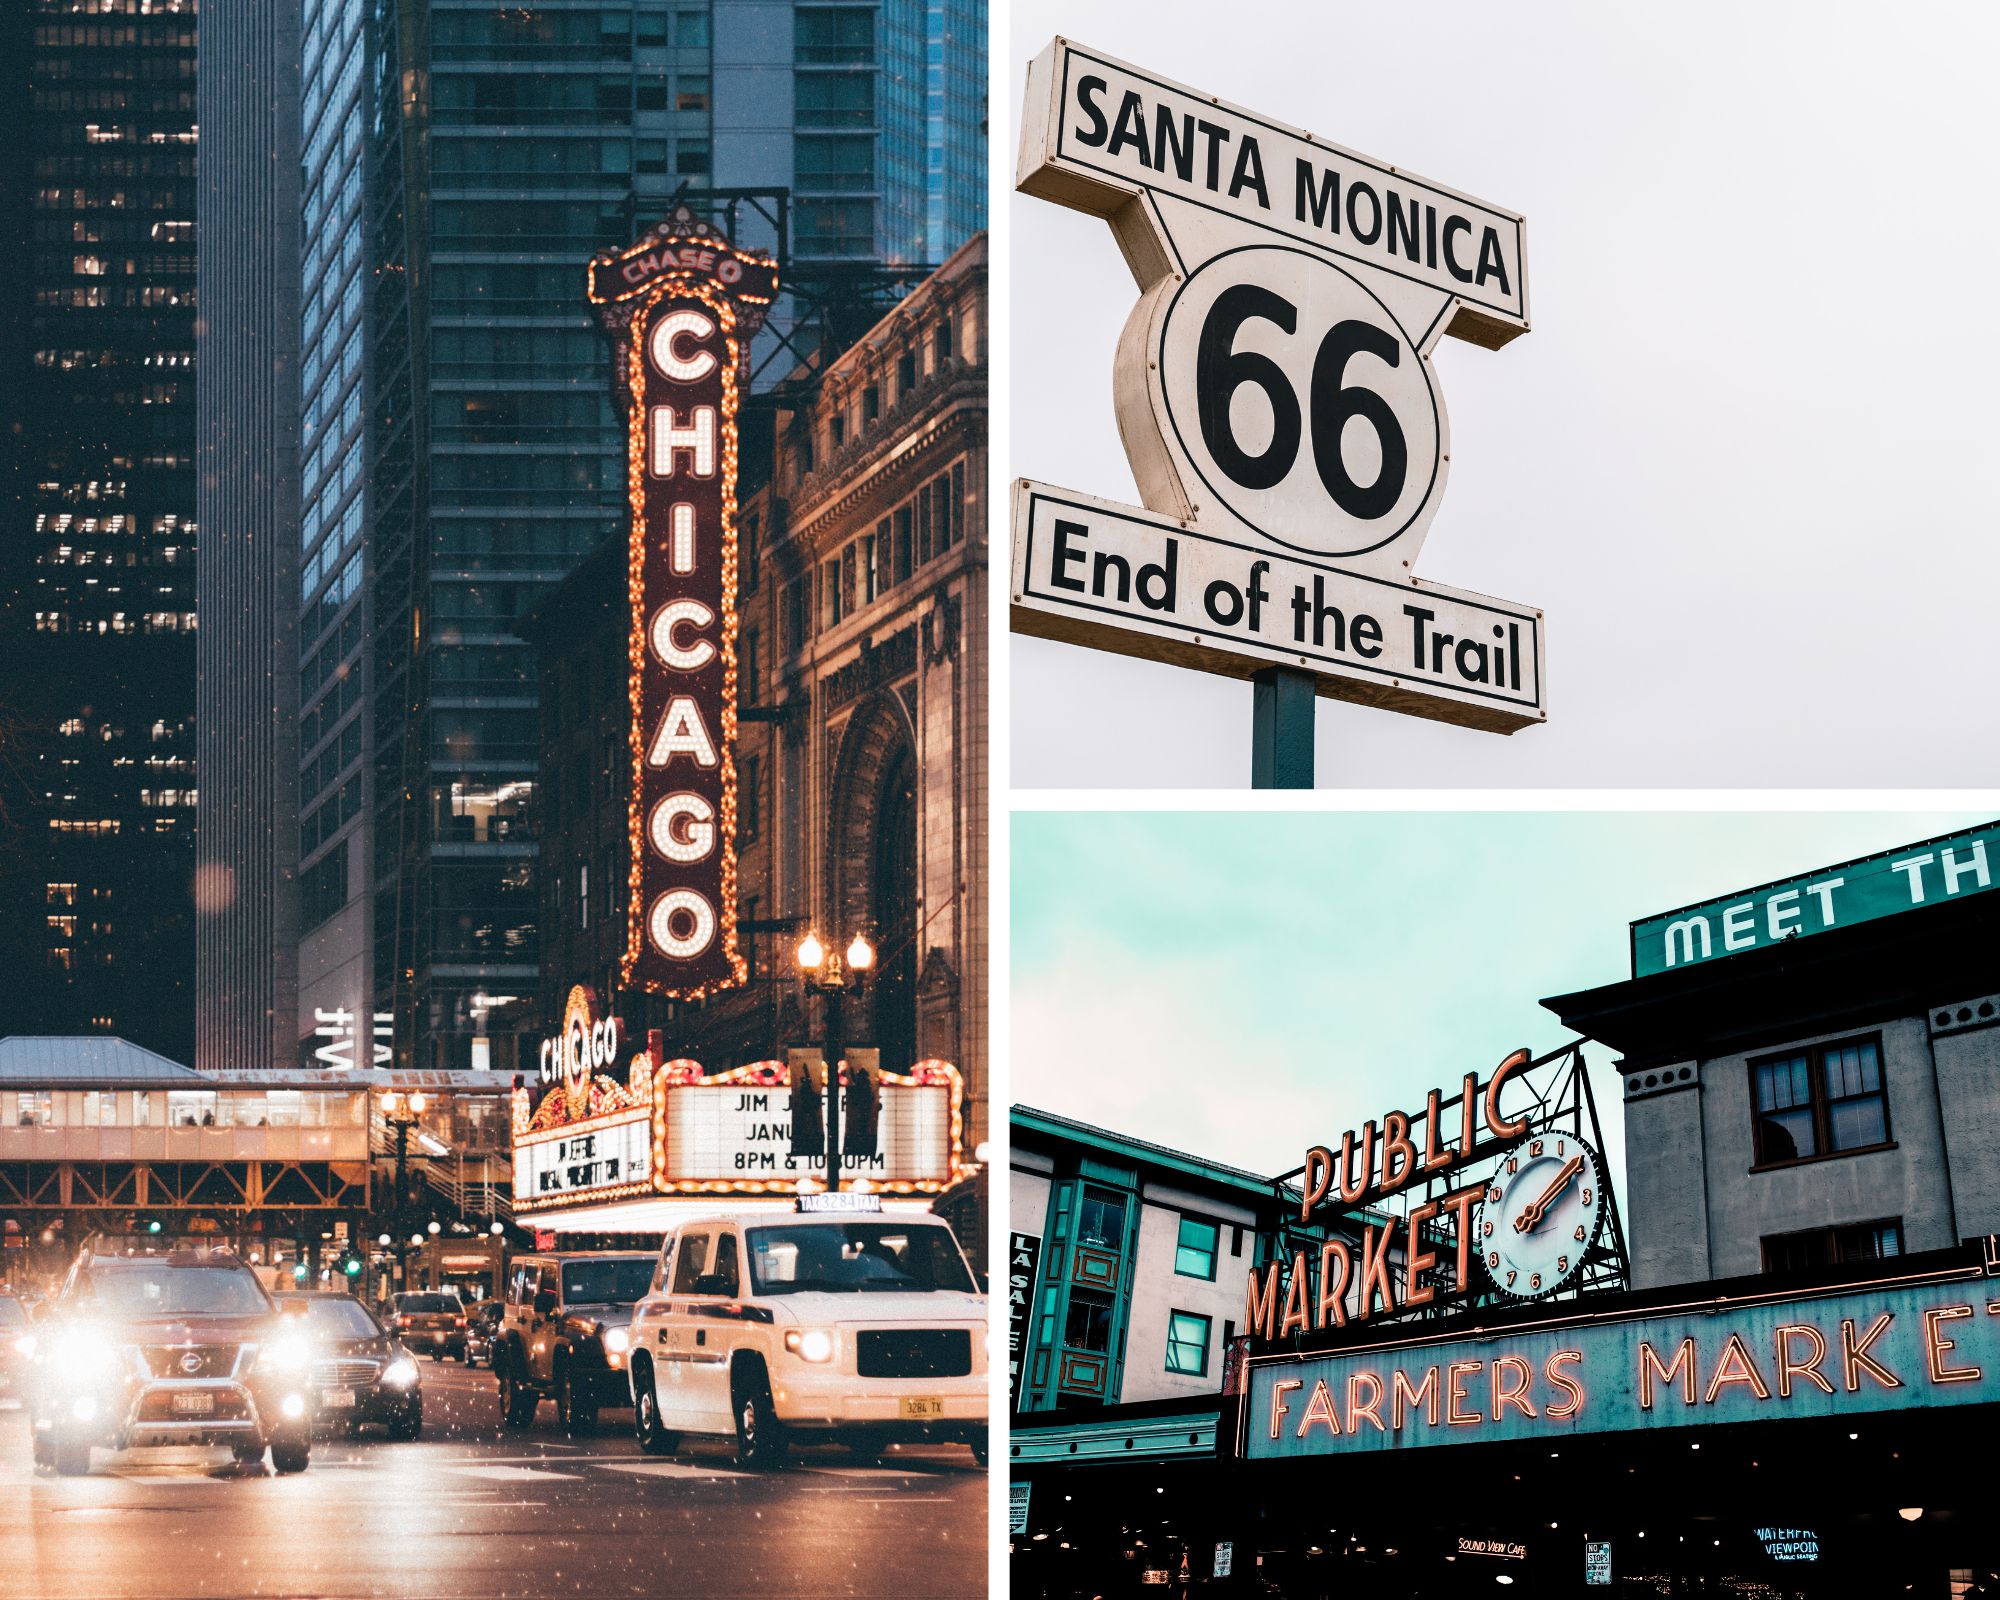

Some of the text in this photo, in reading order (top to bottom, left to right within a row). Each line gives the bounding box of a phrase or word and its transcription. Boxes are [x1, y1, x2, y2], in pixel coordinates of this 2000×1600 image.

[1075, 74, 1512, 297] SANTA MONICA
[622, 248, 717, 284] CHASE
[1196, 283, 1408, 520] 66
[1050, 518, 1521, 692] End of the Trail
[646, 310, 719, 961] CHICAGO
[1664, 839, 1992, 967] MEET TH
[541, 1015, 617, 1084] CHICAGO
[735, 1094, 768, 1112] JIM
[746, 1124, 792, 1141] JANU
[1301, 1047, 1532, 1223] PUBLIC
[1529, 1140, 1543, 1157] 12
[1558, 1140, 1564, 1156] 1
[735, 1152, 775, 1169] 8PM
[1507, 1157, 1517, 1175] 11
[823, 1194, 855, 1209] 3284
[1489, 1187, 1502, 1203] 10
[1582, 1188, 1592, 1205] 3
[1483, 1221, 1493, 1237] 9
[1574, 1225, 1586, 1242] 4
[1244, 1184, 1486, 1341] MARKET
[1489, 1251, 1498, 1268] 8
[1558, 1255, 1568, 1273] 5
[1507, 1270, 1517, 1287] 7
[1530, 1273, 1541, 1289] 6
[1269, 1304, 2000, 1439] FARMERS MARKE
[907, 1401, 941, 1413] 3284 TX
[1458, 1537, 1526, 1555] SOUND VIEW CAFE
[1588, 1544, 1598, 1552] NO
